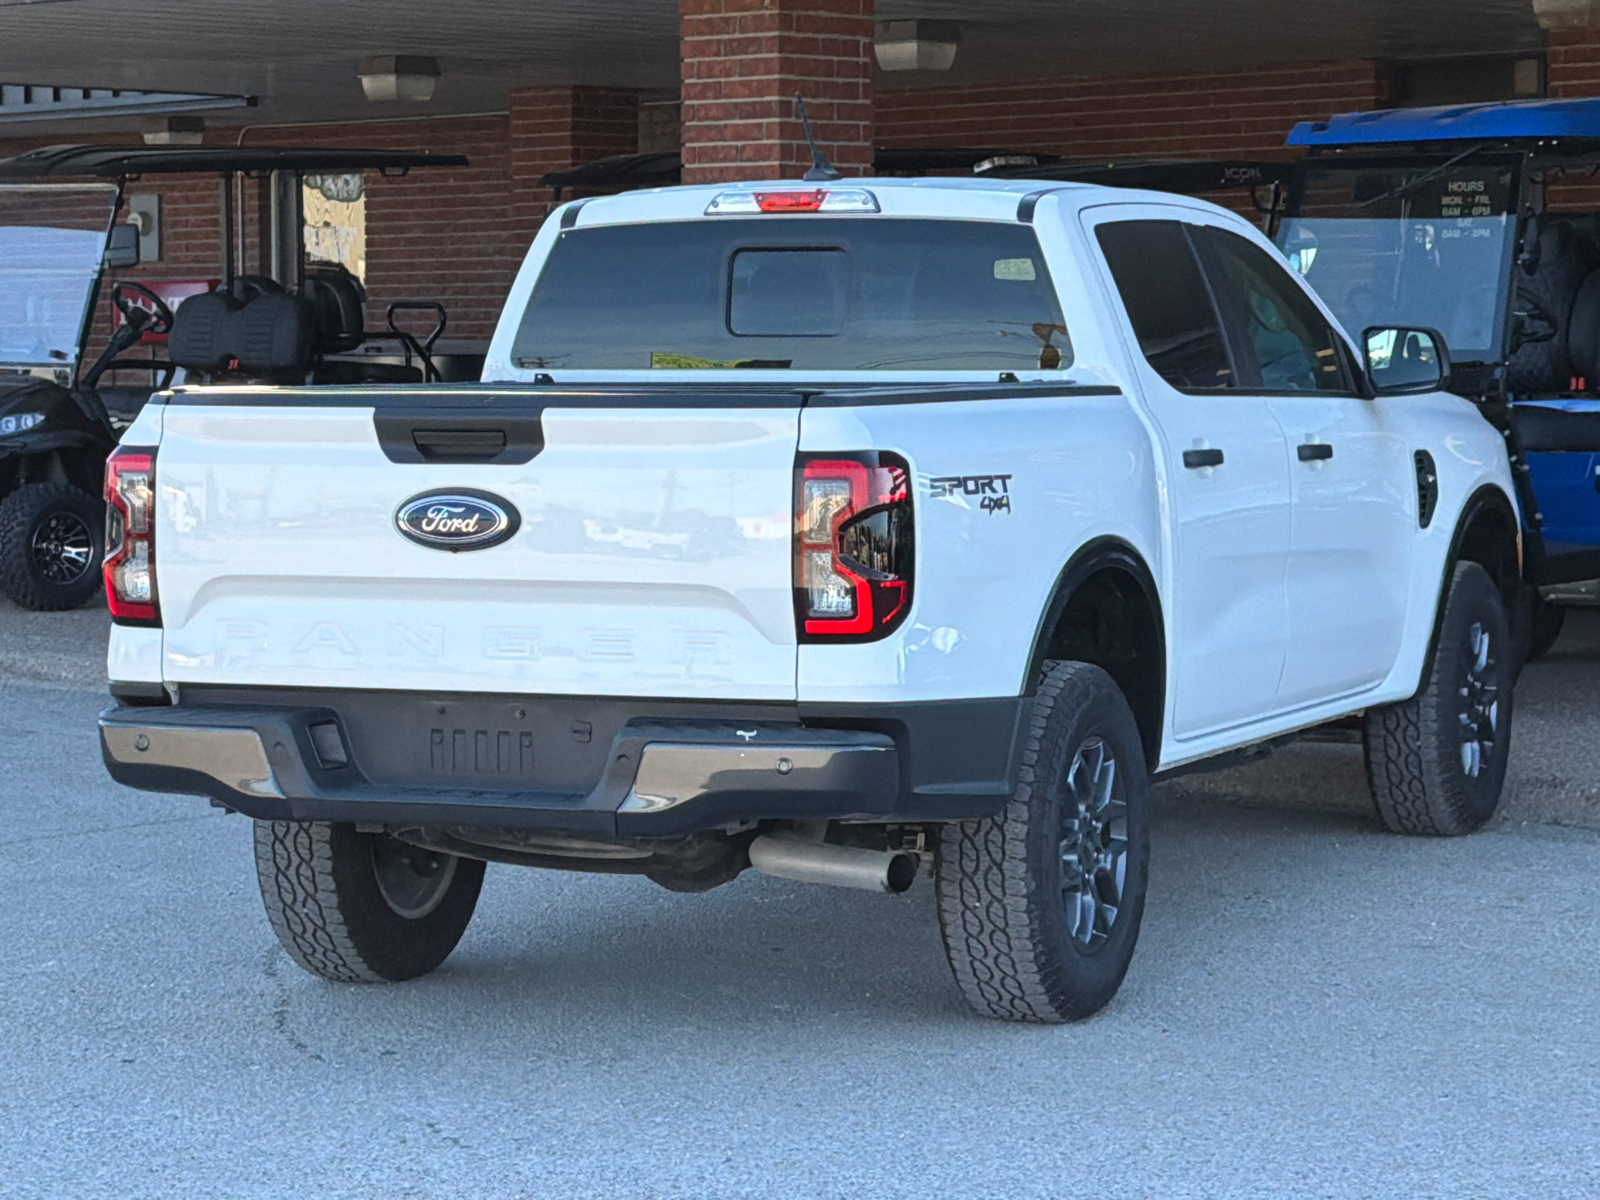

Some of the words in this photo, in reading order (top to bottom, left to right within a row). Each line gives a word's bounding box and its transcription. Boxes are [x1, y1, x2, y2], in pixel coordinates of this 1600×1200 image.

[1448, 181, 1485, 192] HOURS
[929, 474, 1012, 498] SPORT
[421, 505, 480, 532] Ford
[213, 617, 732, 666] RANGER
